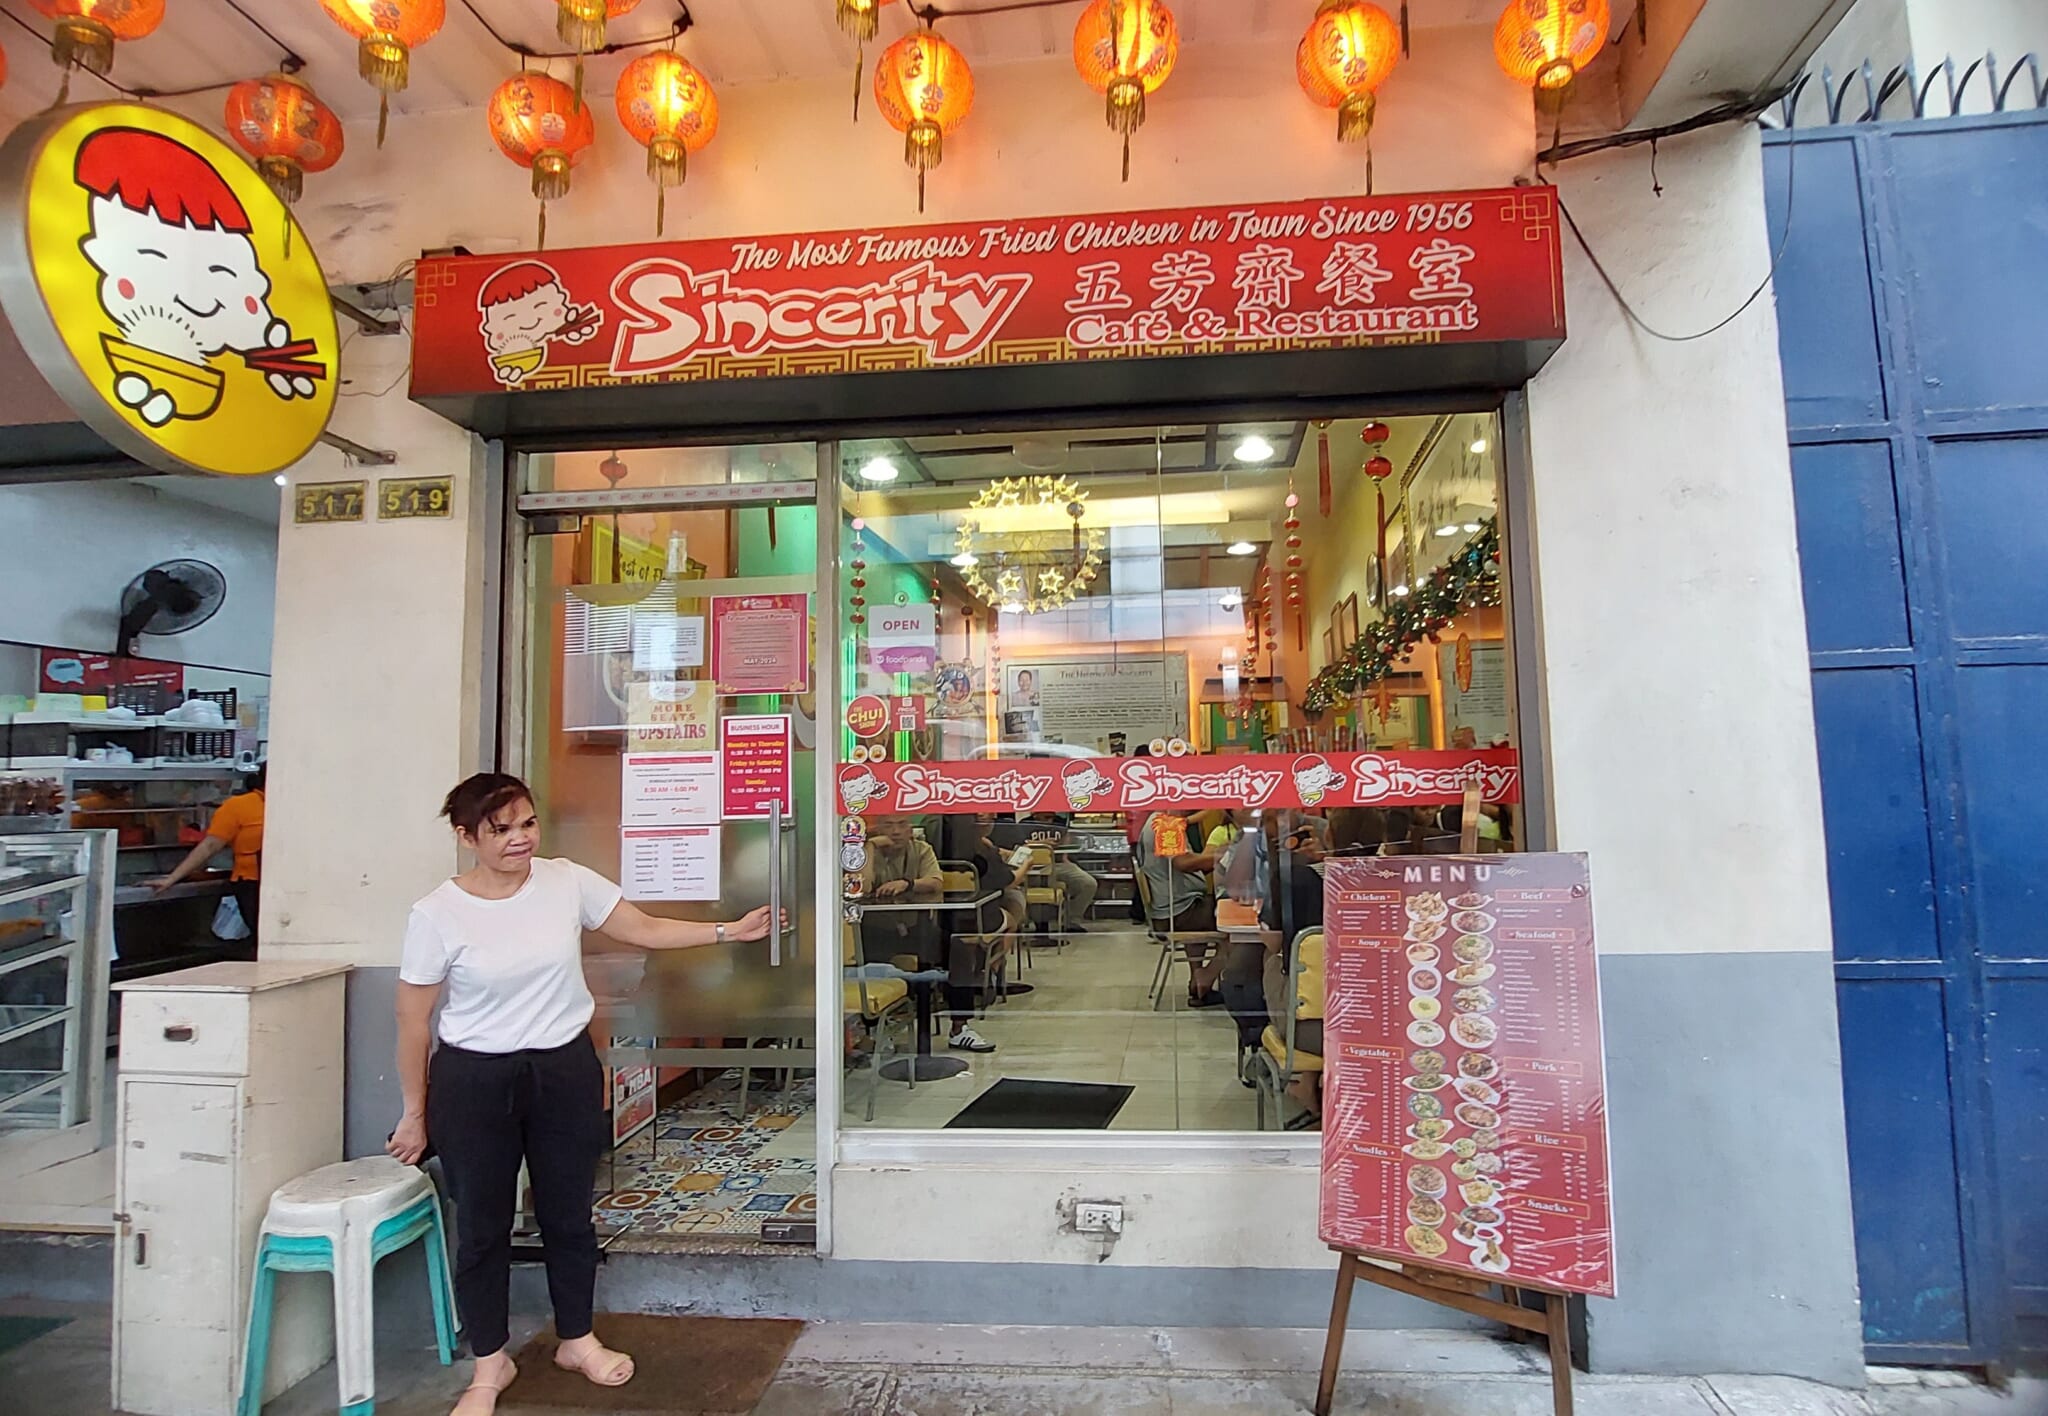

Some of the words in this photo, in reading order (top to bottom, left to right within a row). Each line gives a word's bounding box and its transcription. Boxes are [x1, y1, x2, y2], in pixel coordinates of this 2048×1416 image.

[731, 241, 776, 273] The
[788, 236, 855, 269] Most
[857, 231, 971, 264] Famous
[978, 224, 1058, 258] Fried
[1063, 218, 1184, 252] Chicken
[1189, 213, 1223, 243] in
[1226, 208, 1309, 243] Town
[1311, 204, 1400, 237] Since
[1405, 201, 1474, 232] 1956
[609, 257, 1033, 376] Sincerity
[1065, 308, 1174, 349] Café
[1182, 311, 1227, 343] &
[1235, 299, 1479, 338] Restaurant
[302, 493, 357, 515] 517
[386, 489, 444, 511] 519
[882, 620, 920, 631] OPEN
[886, 655, 927, 665] foodpanda
[653, 704, 693, 712] MORE
[848, 707, 883, 724] CHUI
[638, 724, 706, 740] UPSTAIRS
[894, 764, 1051, 811] Sincerity
[1119, 759, 1282, 807] Sincerity
[1404, 864, 1492, 884] MENU
[1350, 892, 1386, 901] Chicken
[1520, 892, 1544, 900] Beef
[1349, 1046, 1390, 1057] Vegetable
[1532, 1061, 1557, 1072] Pork
[1535, 1133, 1559, 1145] Rice
[1352, 1143, 1388, 1156] Noodles
[1527, 1199, 1569, 1213] Snacks
